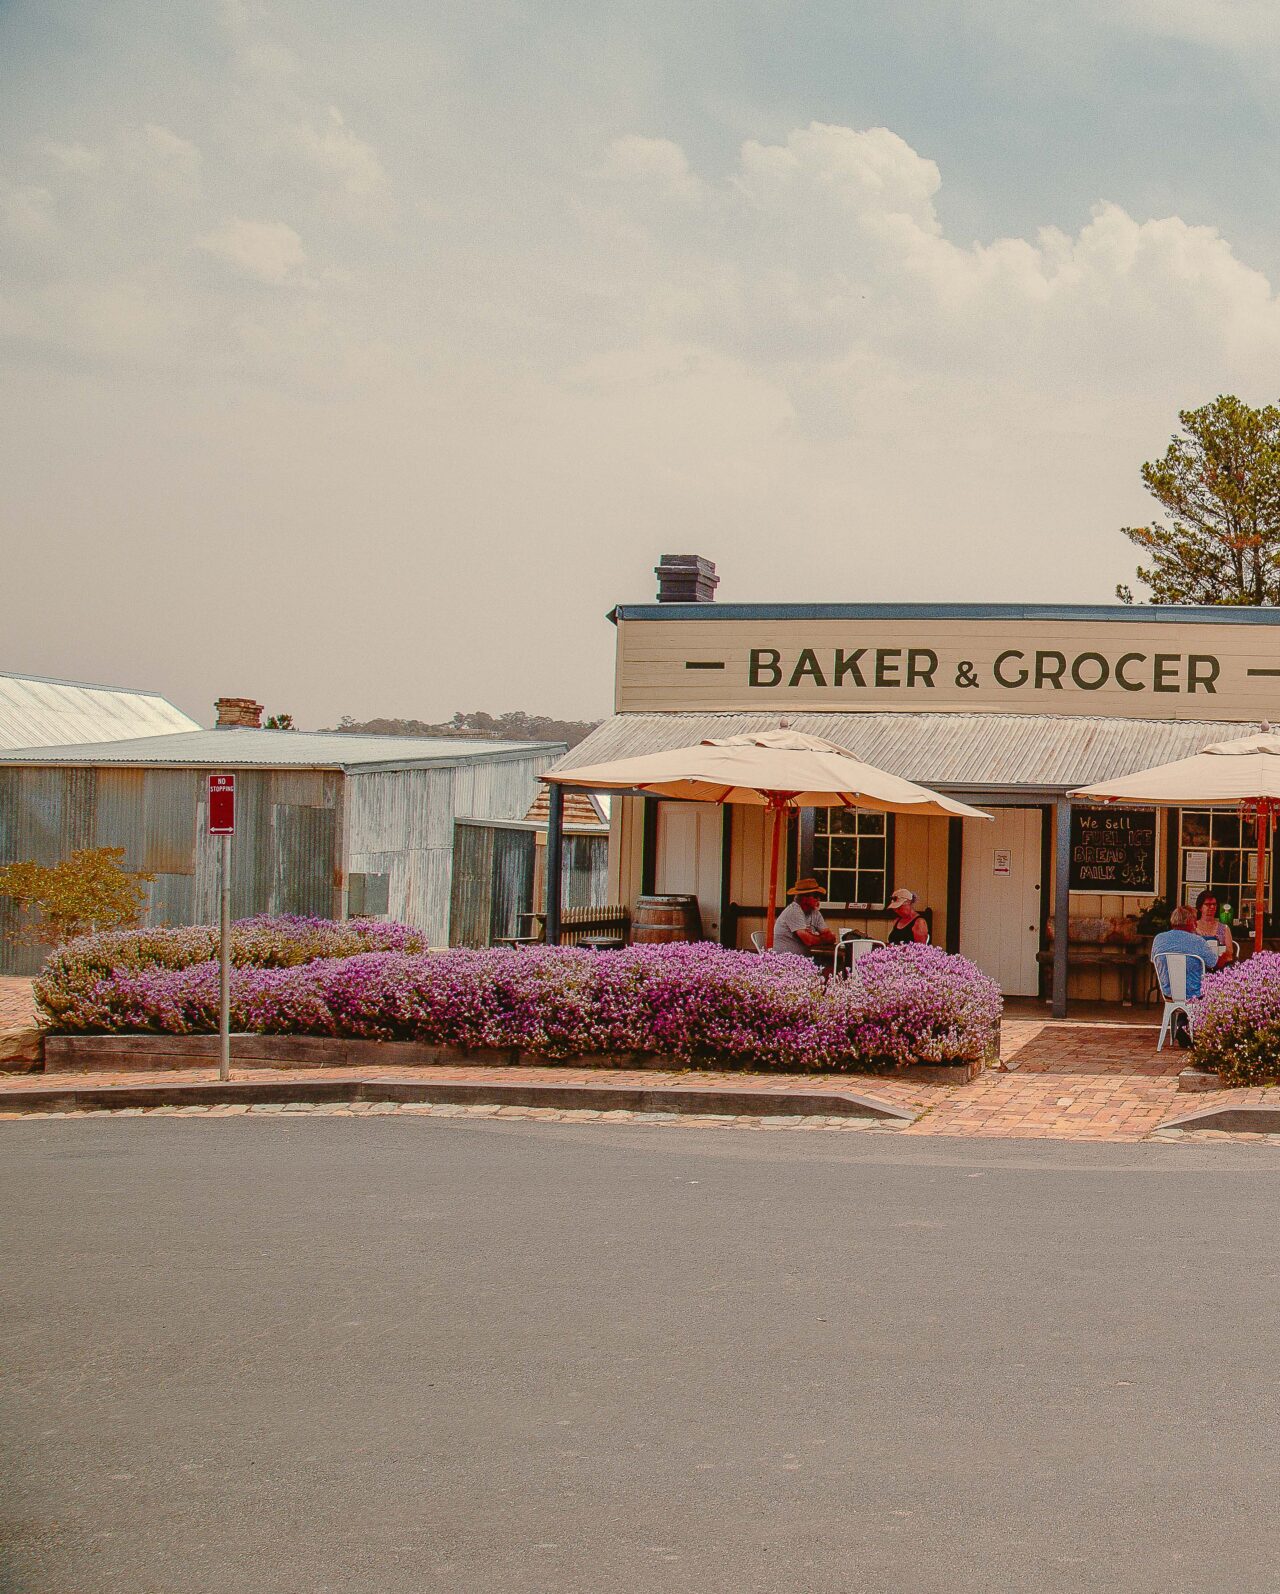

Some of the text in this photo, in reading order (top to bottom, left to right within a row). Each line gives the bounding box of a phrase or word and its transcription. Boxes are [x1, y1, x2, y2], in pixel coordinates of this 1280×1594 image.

[749, 648, 1221, 694] BAKER & GROCER
[1080, 816, 1098, 829] We
[1128, 829, 1153, 847] ICE
[1074, 846, 1127, 863] BREAD
[1080, 865, 1116, 880] MILK
